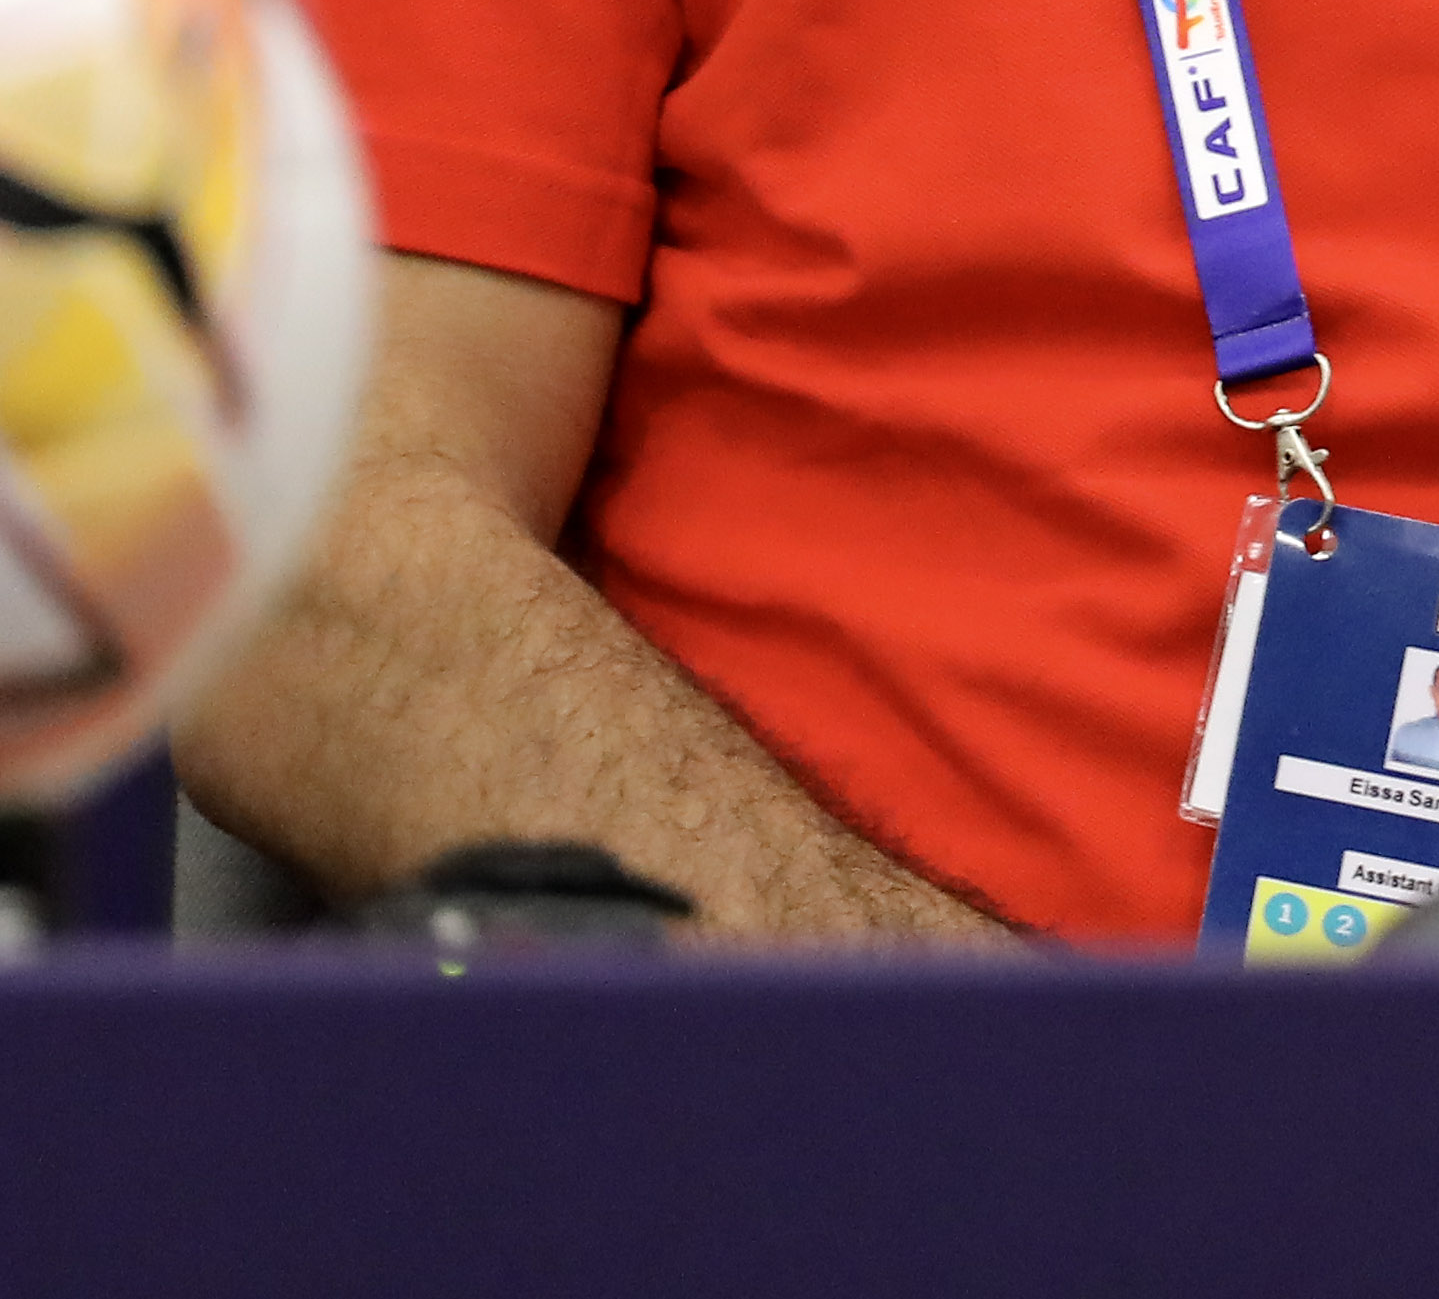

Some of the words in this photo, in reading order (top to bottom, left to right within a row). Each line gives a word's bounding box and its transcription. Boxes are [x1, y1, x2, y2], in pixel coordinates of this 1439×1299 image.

[1192, 77, 1246, 206] CAF
[1349, 777, 1405, 804] Eissa
[1351, 864, 1434, 897] Assistant
[1278, 903, 1292, 924] 1
[1335, 914, 1355, 936] 2
